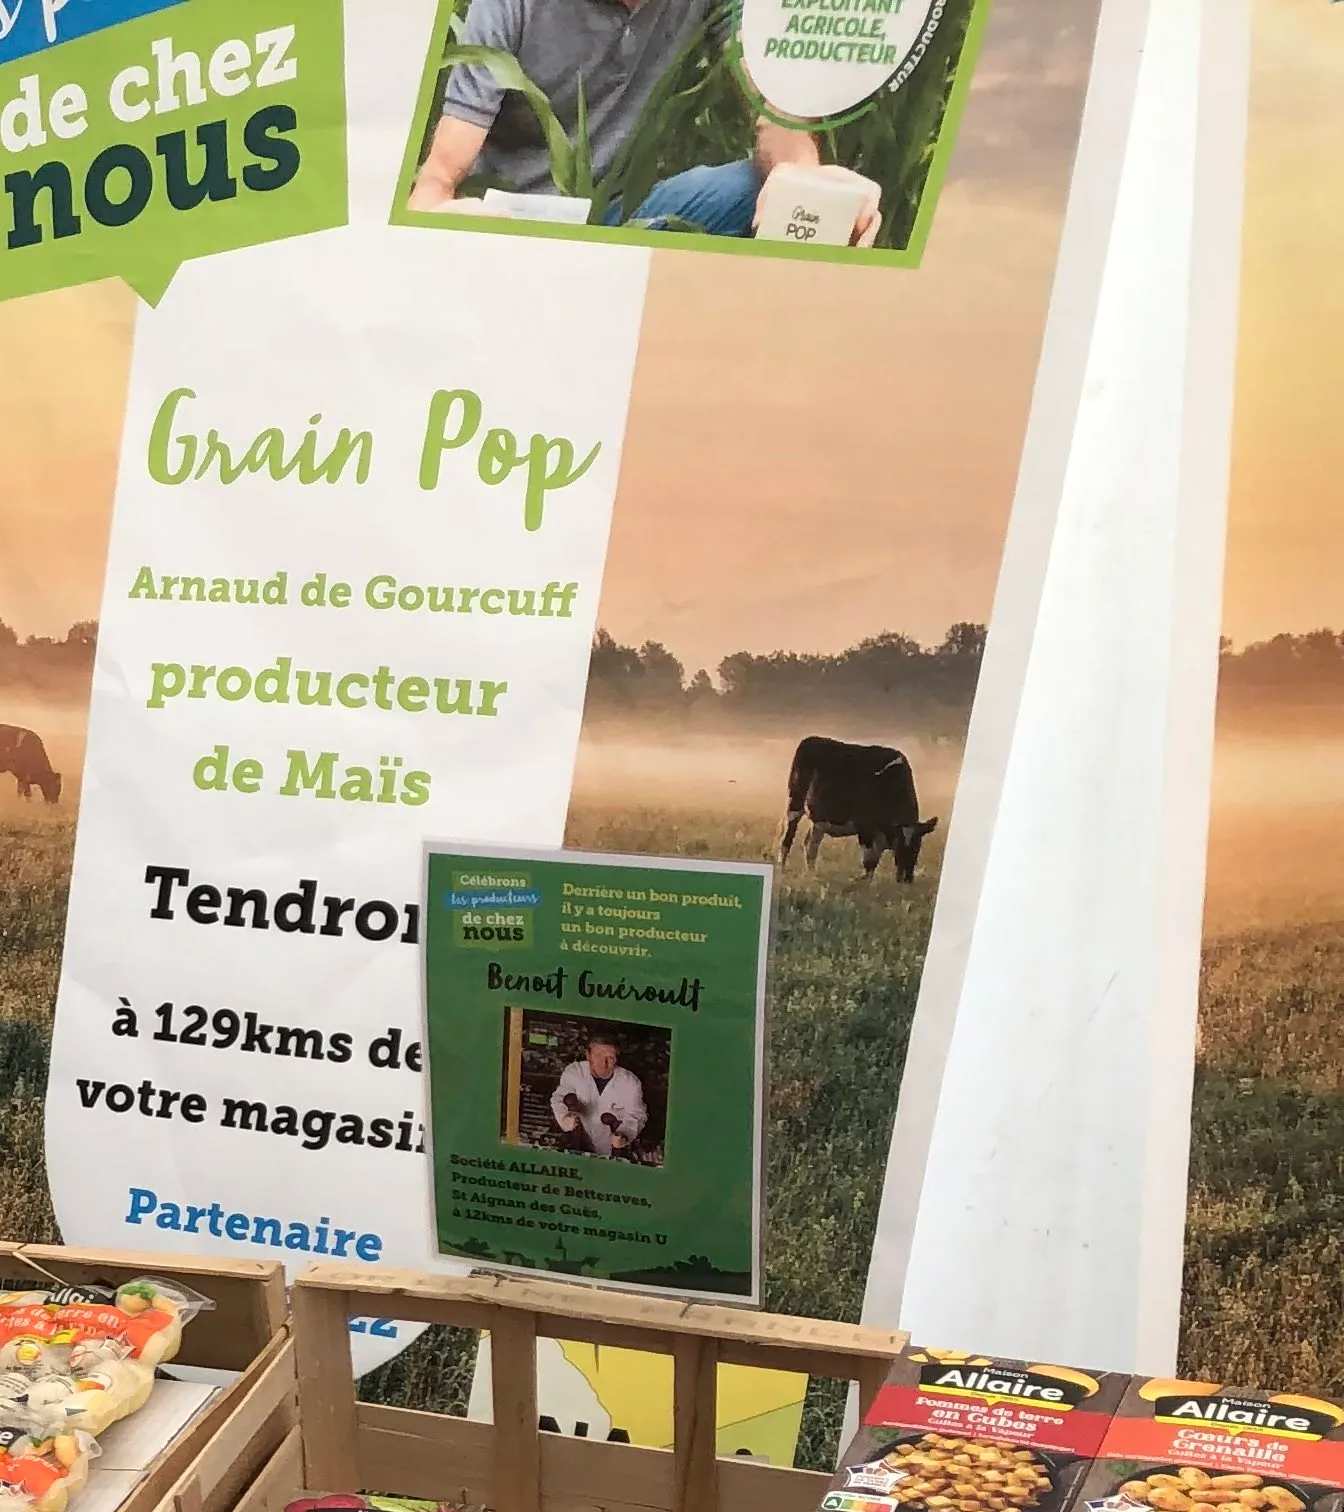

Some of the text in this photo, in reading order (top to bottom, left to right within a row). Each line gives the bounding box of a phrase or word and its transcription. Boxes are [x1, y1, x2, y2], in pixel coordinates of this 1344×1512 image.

[764, 37, 898, 64] PRODUCTEUR
[0, 24, 298, 153] de chez
[4, 105, 302, 250] nous
[147, 387, 601, 531] Grain Pop
[128, 566, 578, 618] Arnaud de Gourcuff
[147, 656, 508, 717] producteur
[193, 745, 432, 807] de Maïs
[462, 912, 525, 926] de chez
[626, 889, 646, 901] un
[649, 889, 679, 904] bon
[463, 925, 524, 942] nous
[578, 969, 705, 1012] Guéroult
[111, 997, 139, 1038] à
[153, 1002, 354, 1064] 129kms
[76, 1078, 208, 1123] votre
[125, 1187, 384, 1262] Partenaire
[935, 1370, 1065, 1401] Allaire
[1174, 1399, 1311, 1430] Allaire
